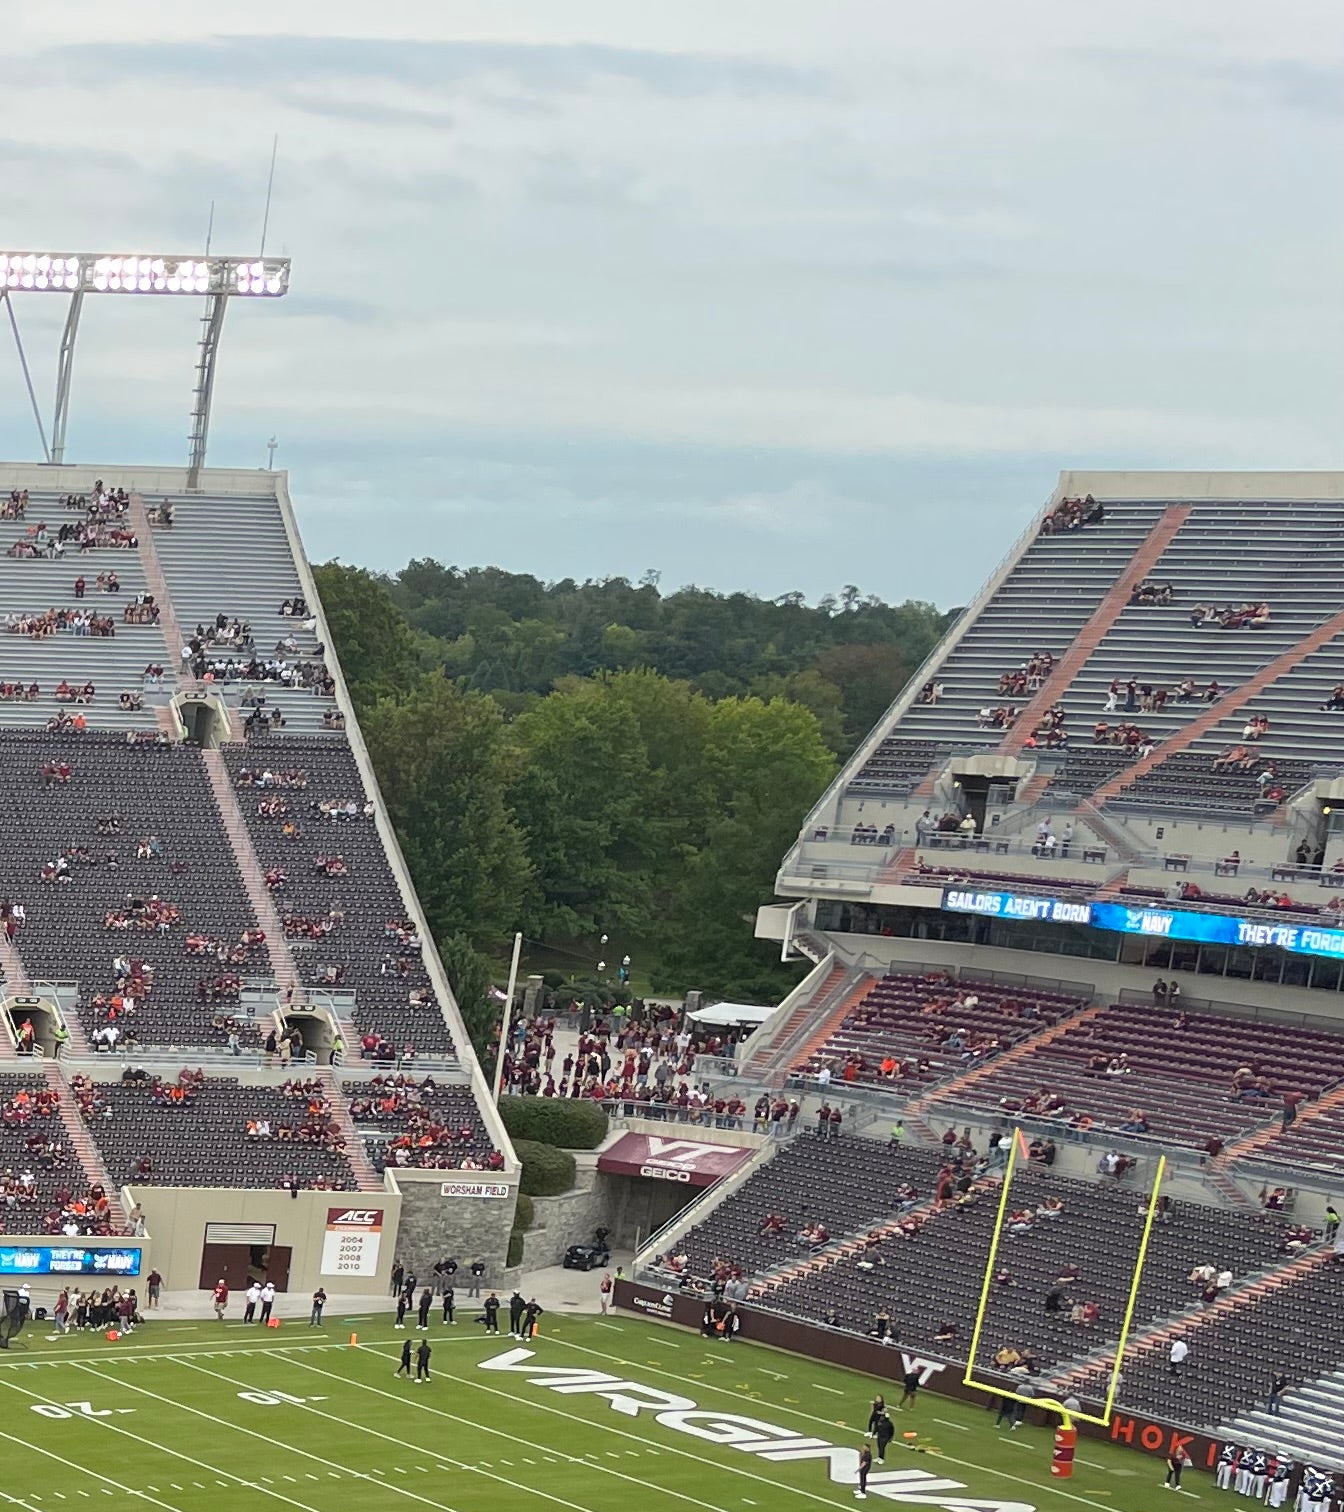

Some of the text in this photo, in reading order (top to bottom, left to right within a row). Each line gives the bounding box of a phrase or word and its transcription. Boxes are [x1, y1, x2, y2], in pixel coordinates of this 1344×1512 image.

[947, 890, 1002, 913] SAILORS
[1004, 896, 1052, 918] AREN'T
[1053, 903, 1091, 924] BORN
[1141, 913, 1173, 934] NAVY
[1238, 923, 1297, 948] THEY'RE
[645, 1136, 743, 1162] VT
[640, 1166, 691, 1183] GEICO
[443, 1185, 507, 1197] WORSHAM FIELD
[332, 1210, 379, 1225] ACC
[900, 1353, 948, 1386] VT
